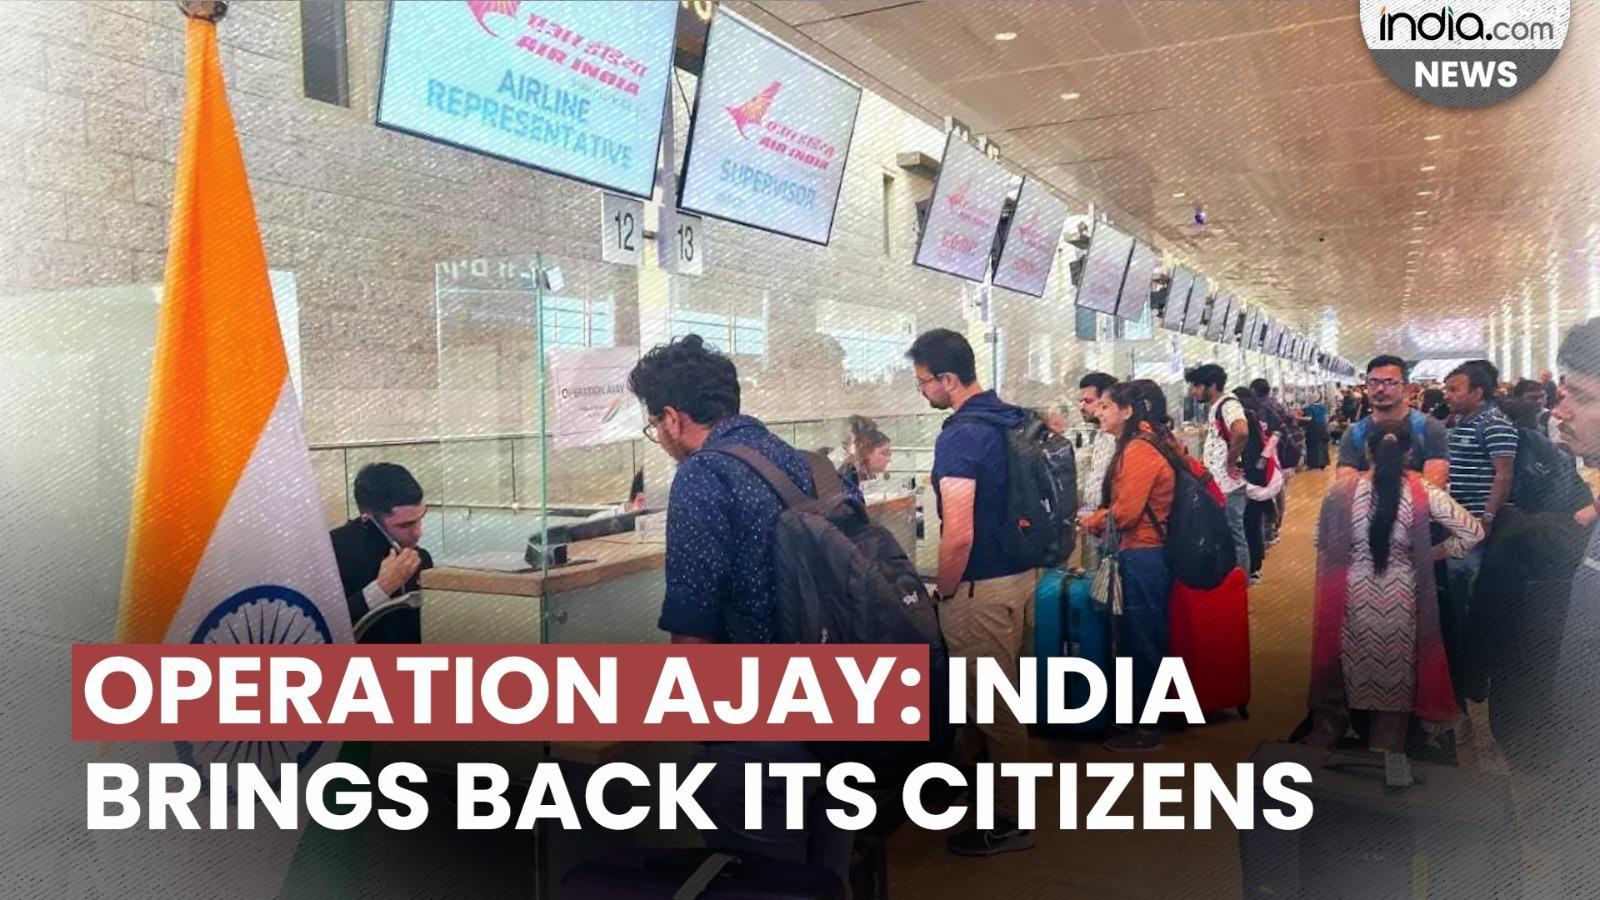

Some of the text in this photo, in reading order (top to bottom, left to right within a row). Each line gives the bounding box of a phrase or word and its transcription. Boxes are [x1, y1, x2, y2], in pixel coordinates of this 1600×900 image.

[515, 35, 568, 65] AIR
[570, 57, 640, 96] INDIA
[496, 69, 591, 122] AIRLINE
[425, 79, 634, 169] REPRESENTATIVE
[758, 137, 830, 171] AIR INDIA
[720, 159, 817, 209] SUPERVISOR
[614, 211, 635, 252] 12
[677, 224, 694, 262] 13
